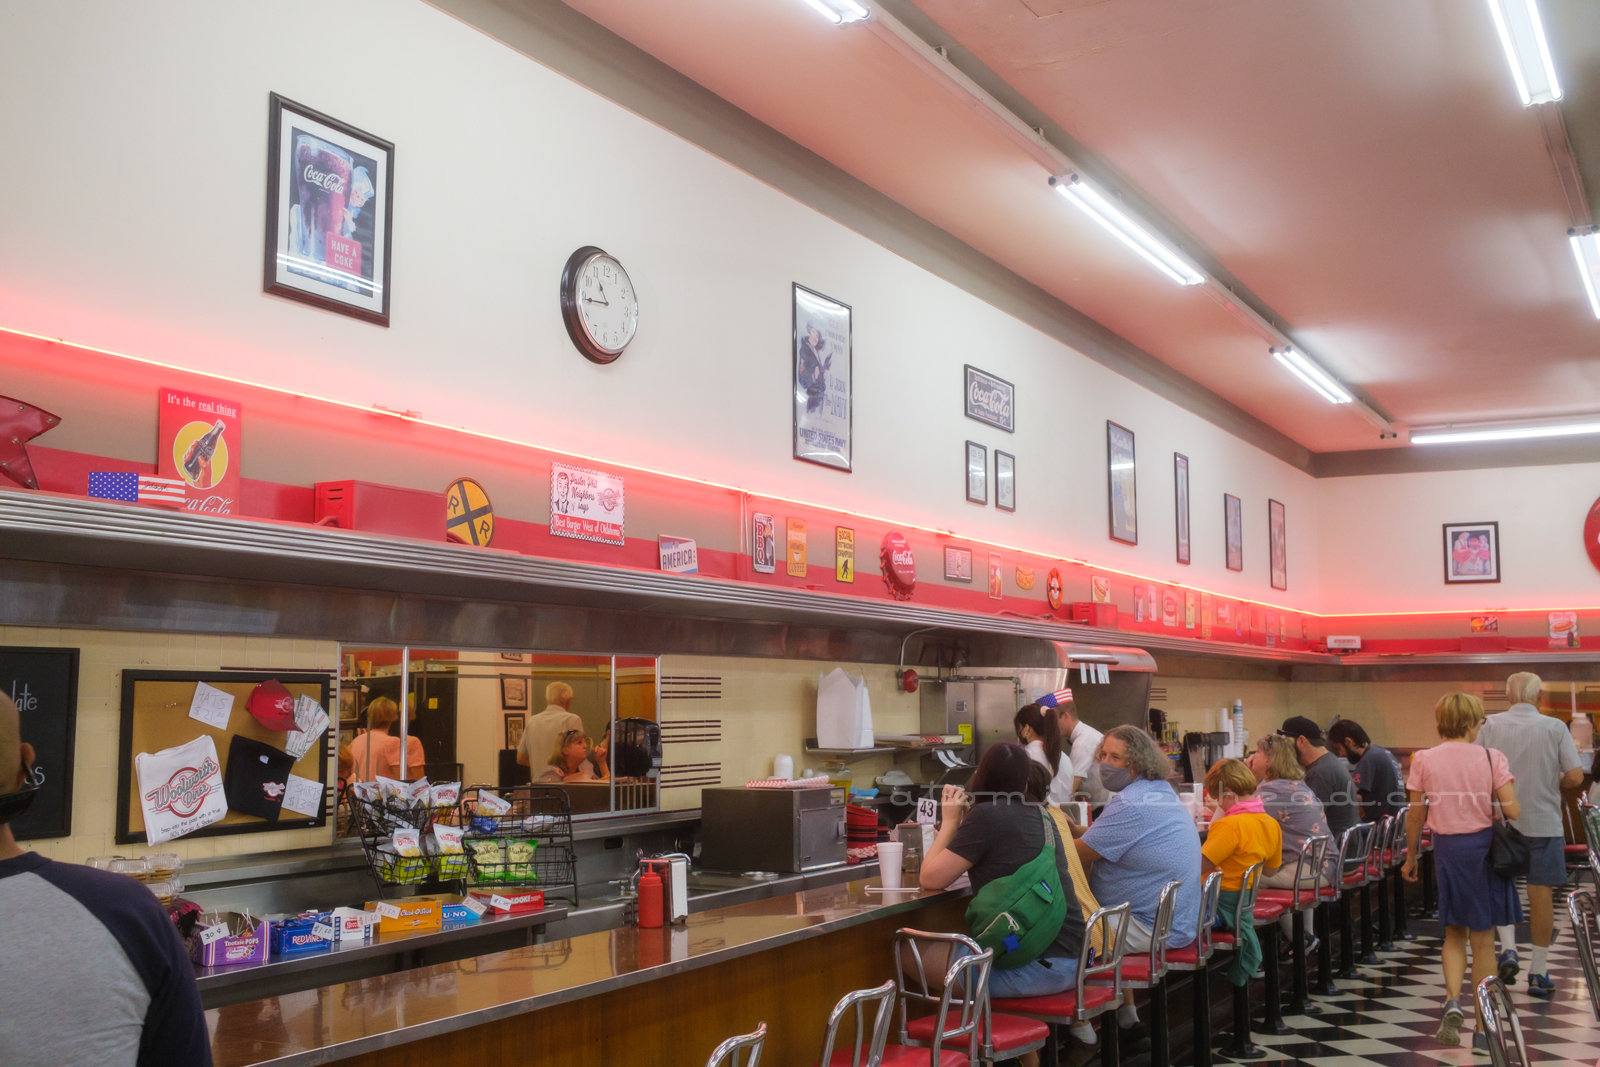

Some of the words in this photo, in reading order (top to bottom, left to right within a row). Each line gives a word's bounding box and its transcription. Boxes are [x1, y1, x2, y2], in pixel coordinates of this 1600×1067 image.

[303, 164, 346, 195] Coca-Cola
[331, 239, 349, 255] HAVE
[351, 243, 357, 257] A
[334, 252, 353, 268] COKE
[593, 265, 599, 278] 11
[603, 265, 610, 278] 12
[614, 272, 618, 284] 1
[585, 275, 592, 288] 10
[621, 287, 626, 299] 2
[624, 306, 629, 317] 3
[593, 324, 598, 336] 7
[621, 321, 625, 333] 4
[603, 332, 607, 343] 6
[614, 331, 618, 342] 5
[167, 394, 180, 405] It's
[183, 397, 196, 408] the
[198, 402, 214, 411] real
[216, 404, 237, 418] thing
[800, 427, 817, 440] UNITED
[819, 432, 834, 445] STATES
[835, 437, 846, 448] NAVY
[570, 473, 586, 486] Pastor
[587, 477, 598, 489] Phil
[571, 486, 595, 502] Neighbors
[447, 494, 459, 515] R
[577, 502, 589, 514] says
[479, 519, 490, 540] R
[566, 516, 581, 533] Burger
[582, 520, 594, 533] West
[594, 521, 600, 532] of
[662, 549, 693, 571] AMERICA
[789, 562, 805, 573] COFFEE
[196, 687, 230, 709] HATS
[146, 757, 218, 809] Woolworth
[1353, 773, 1361, 784] &
[182, 783, 209, 806] Diner
[919, 800, 934, 818] 43
[188, 816, 198, 825] past
[180, 826, 195, 835] Burger
[509, 894, 531, 904] LOOK!
[204, 931, 215, 940] 30
[244, 937, 259, 945] POPS
